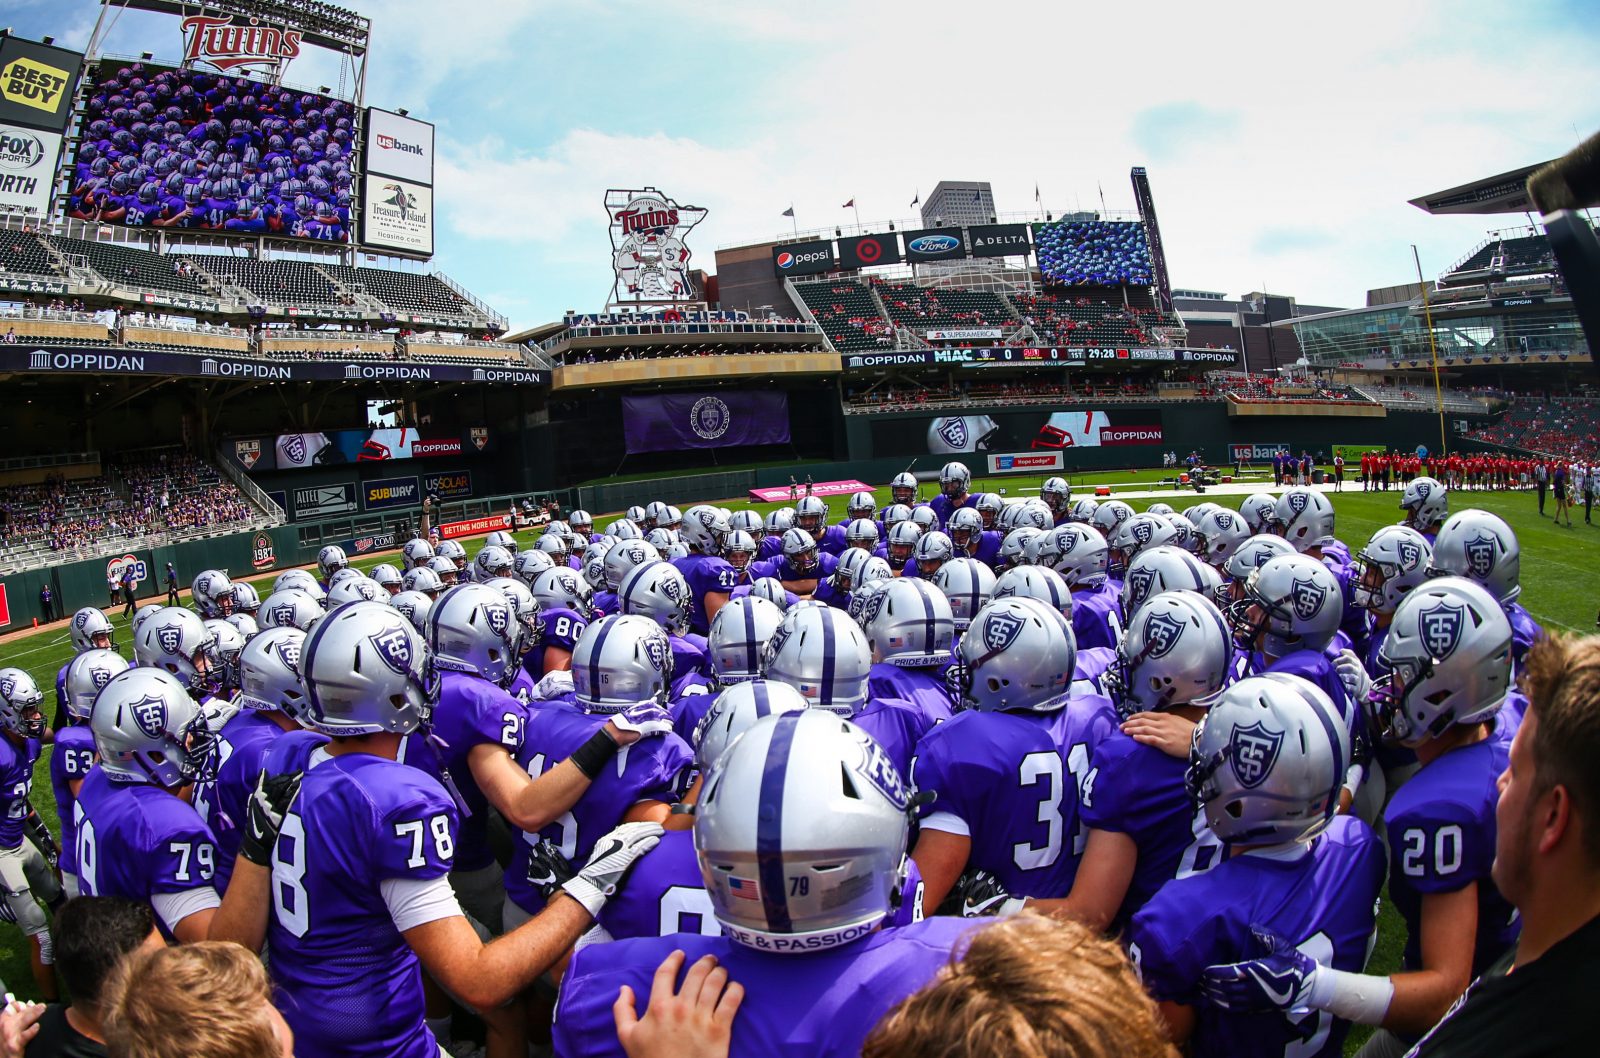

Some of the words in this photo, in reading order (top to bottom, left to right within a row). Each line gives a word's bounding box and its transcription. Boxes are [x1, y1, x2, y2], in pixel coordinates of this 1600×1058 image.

[180, 15, 301, 60] Twins
[10, 63, 65, 92] BEST
[7, 79, 56, 104] BUY
[0, 135, 34, 156] FOX
[125, 207, 144, 226] 26
[372, 203, 400, 218] Treasure
[407, 211, 426, 223] Island
[615, 207, 679, 235] Twins
[316, 224, 333, 240] 74
[920, 239, 950, 251] Ford
[987, 236, 1026, 245] DELTA
[795, 249, 829, 265] pepsi
[864, 355, 925, 365] OPPIDAN
[934, 350, 972, 362] MIAC
[1004, 350, 1012, 360] 0
[1051, 349, 1058, 359] 0
[1088, 349, 1115, 358] 29:28
[1193, 352, 1235, 362] OPPIDAN
[54, 354, 144, 371] OPPIDAN
[220, 362, 291, 379] OPPIDAN
[363, 366, 431, 379] OPPIDAN
[487, 370, 540, 383] OPPIDAN
[1114, 431, 1162, 441] OPPIDAN
[238, 441, 258, 451] MLB
[423, 443, 461, 453] OPPIDAN
[297, 489, 318, 504] ALTEC
[369, 485, 412, 501] SUBWAY
[444, 523, 470, 534] GETTING
[471, 521, 489, 531] MORE
[489, 519, 503, 529] KIDS
[355, 538, 373, 551] Twins
[254, 547, 273, 560] 1987
[719, 571, 735, 587] 41
[555, 617, 585, 641] 80
[894, 658, 921, 666] PRIDE
[600, 674, 609, 684] 15
[65, 750, 94, 774] 63
[396, 814, 454, 869] 78
[1402, 824, 1463, 876] 20
[170, 843, 215, 881] 79
[756, 936, 772, 949] &
[773, 922, 872, 950] PASSION
